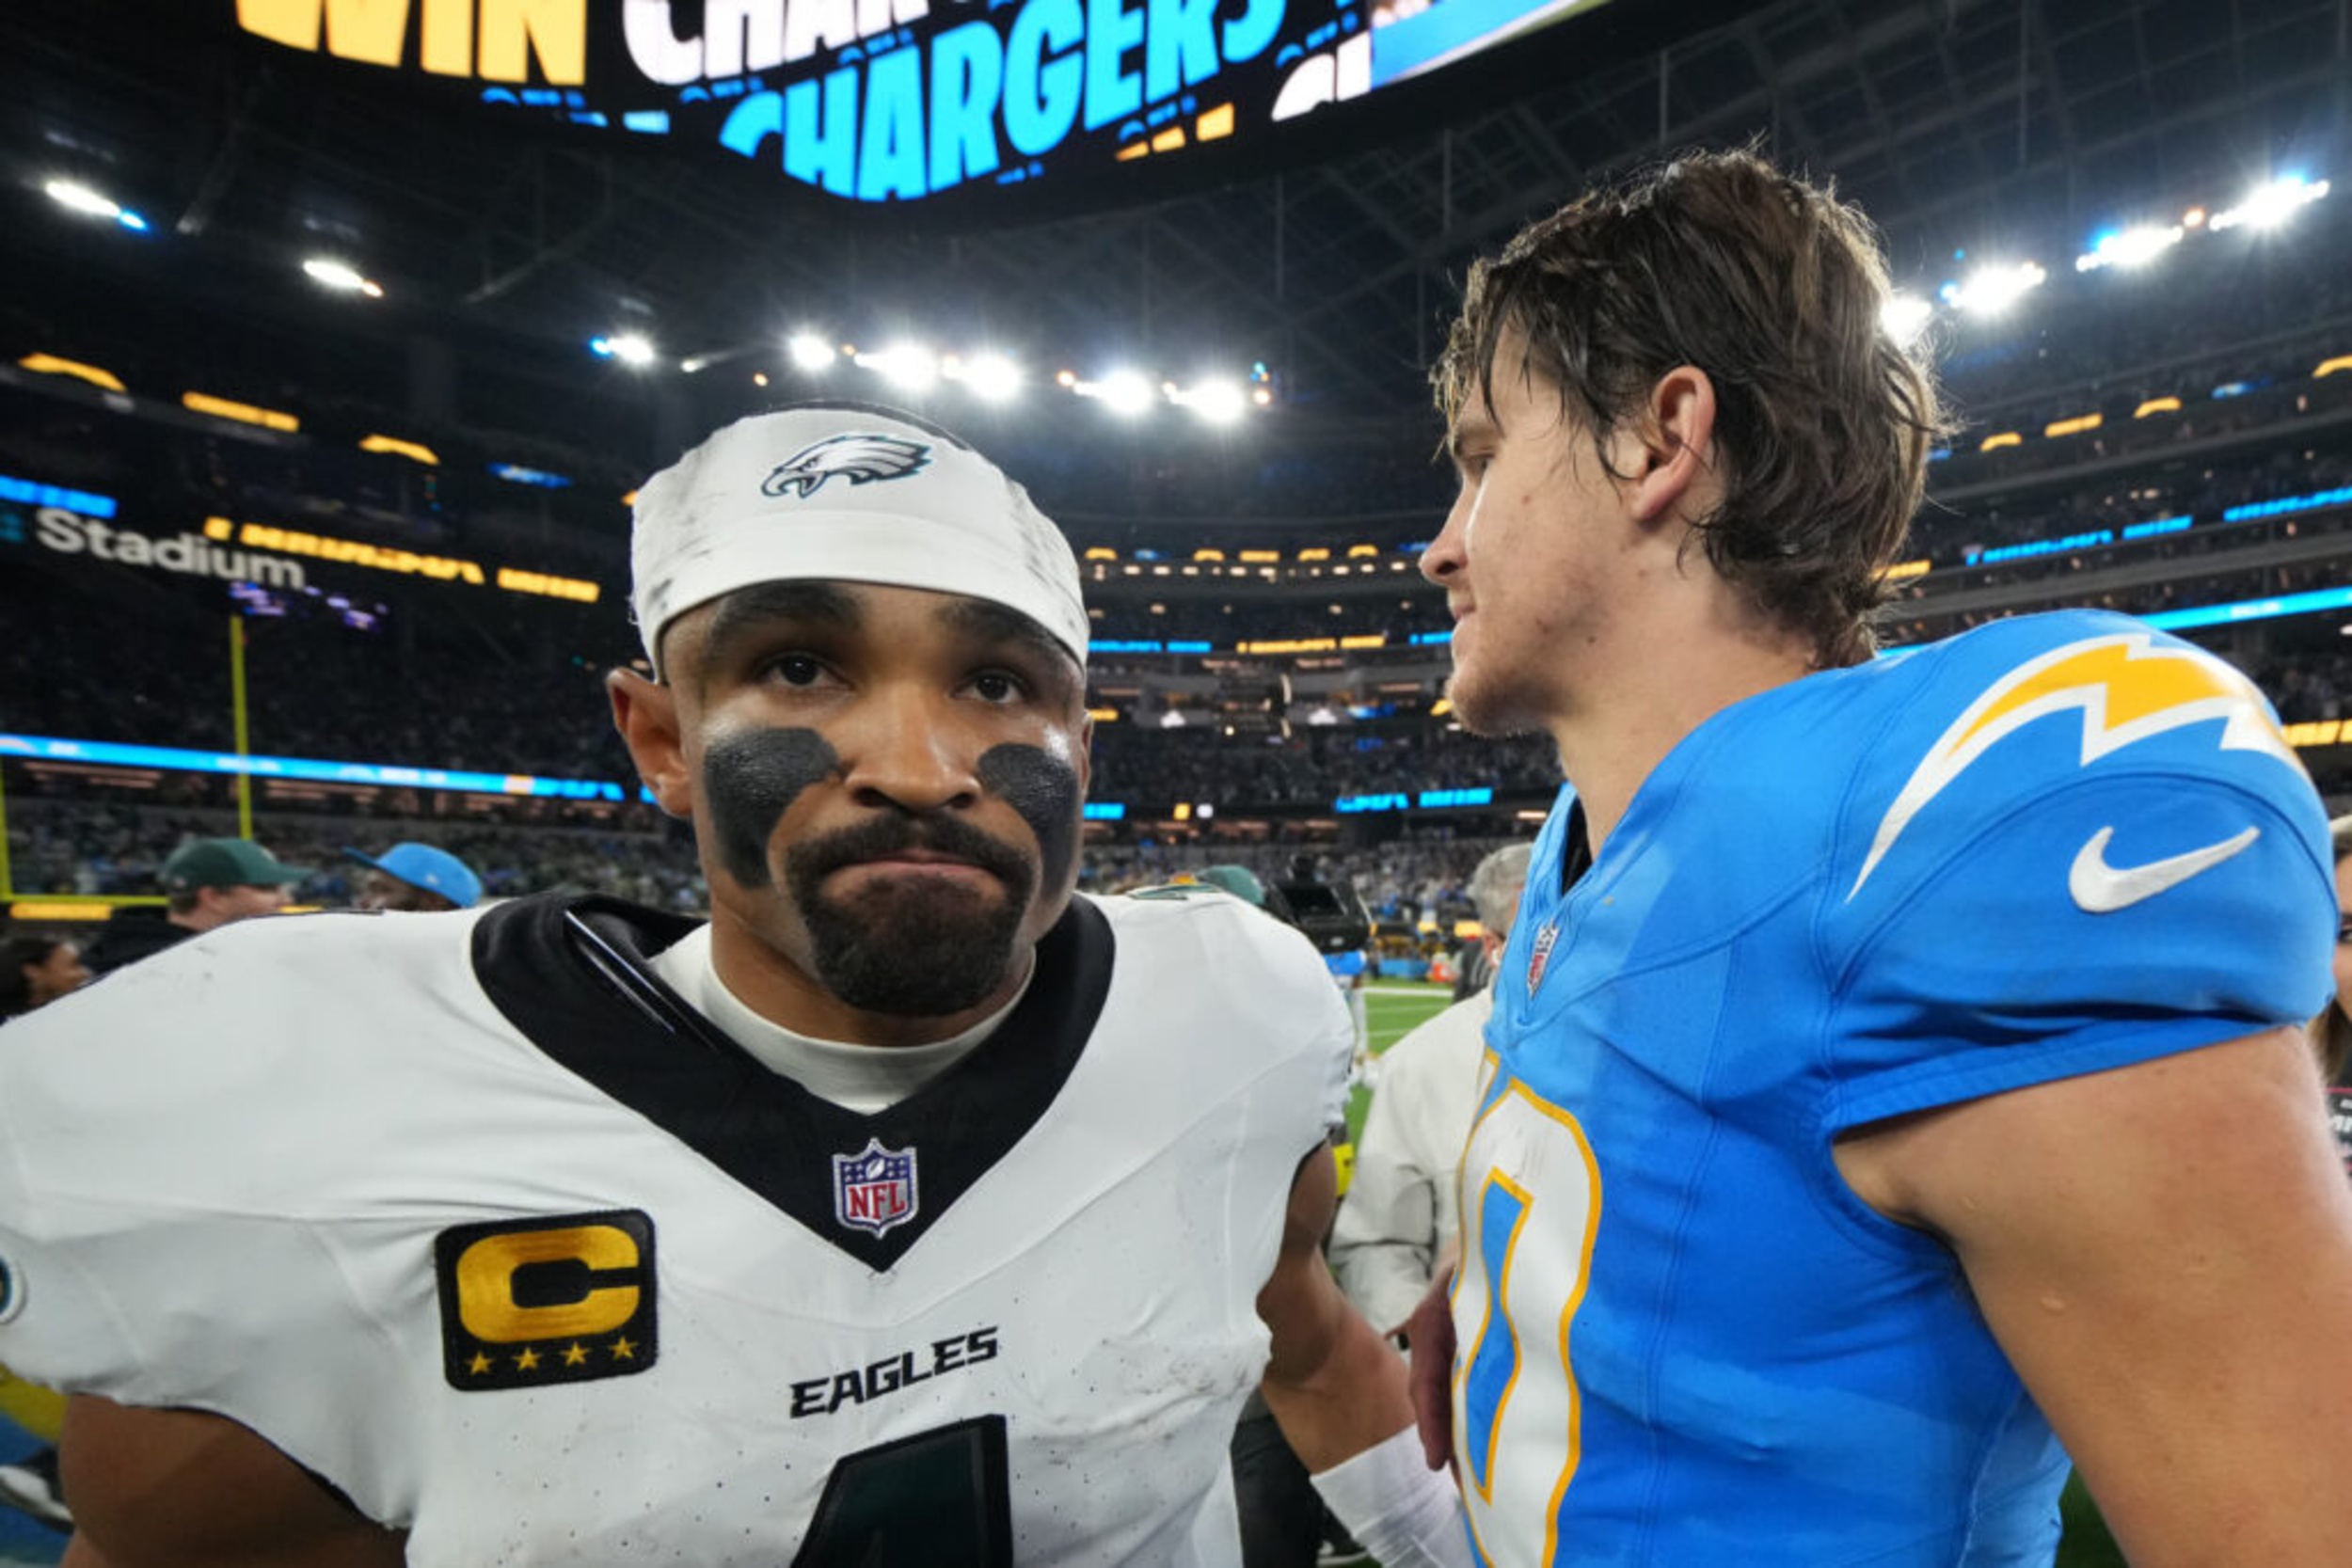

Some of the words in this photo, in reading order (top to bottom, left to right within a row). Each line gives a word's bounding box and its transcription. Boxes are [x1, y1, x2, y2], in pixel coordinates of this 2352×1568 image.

[623, 0, 929, 86] CHA
[36, 507, 305, 590] Stadium
[849, 1181, 908, 1220] NFL
[456, 1225, 640, 1344] C
[789, 1325, 998, 1419] EAGLES
